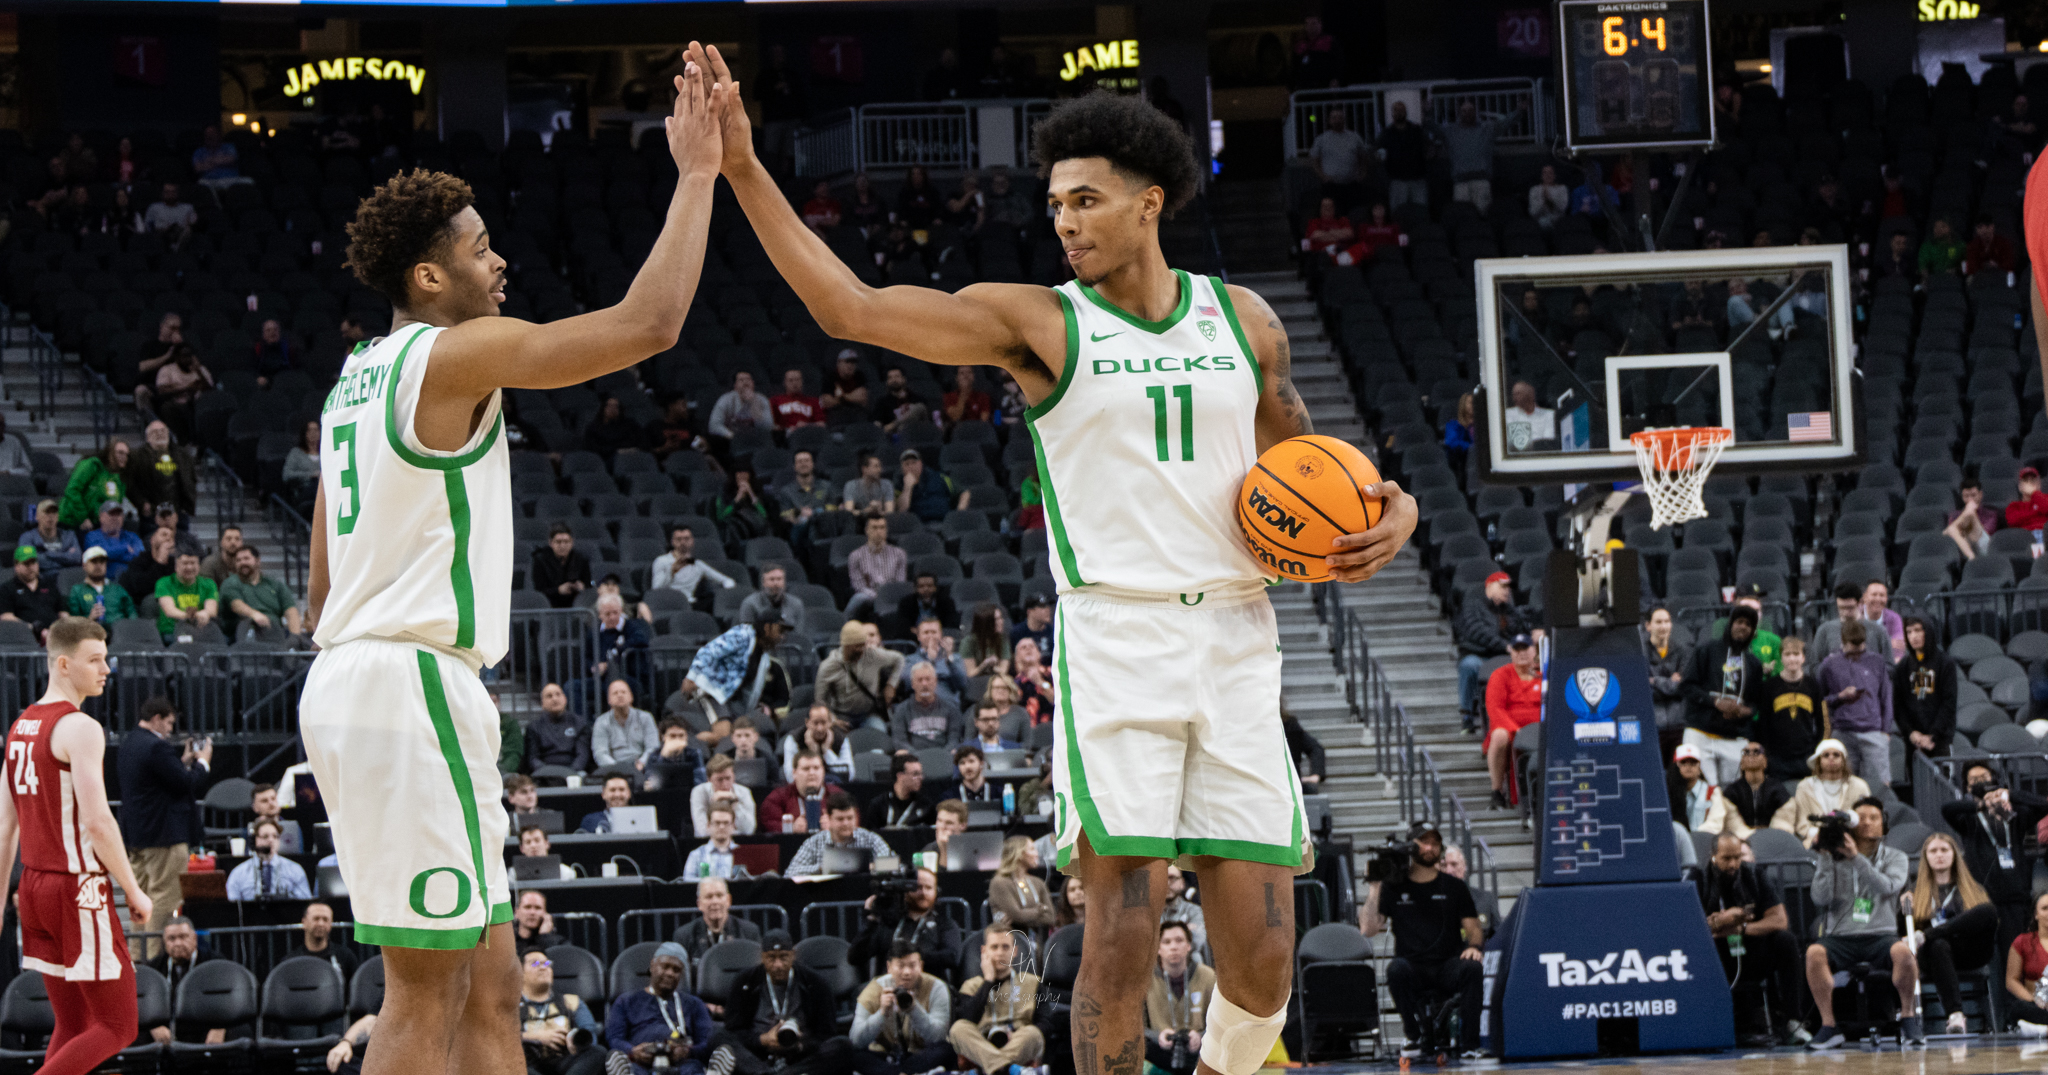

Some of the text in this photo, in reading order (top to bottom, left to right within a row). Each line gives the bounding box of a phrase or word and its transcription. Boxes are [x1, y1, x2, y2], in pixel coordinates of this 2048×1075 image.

[1597, 2, 1668, 13] DAKTRONICS
[1507, 16, 1540, 48] 20
[1602, 16, 1667, 57] 6.4
[131, 43, 145, 74] 1
[283, 57, 426, 97] JAMESON
[1060, 39, 1140, 81] JAME
[1092, 355, 1236, 375] DUCKS
[323, 363, 392, 415] THELEMY
[1145, 384, 1194, 462] 11
[332, 421, 361, 536] 3
[1248, 485, 1306, 539] NCAA
[9, 741, 39, 795] 24
[409, 866, 472, 919] O
[1539, 949, 1689, 987] TaxAct
[1562, 999, 1678, 1020] #PAC12MBB
